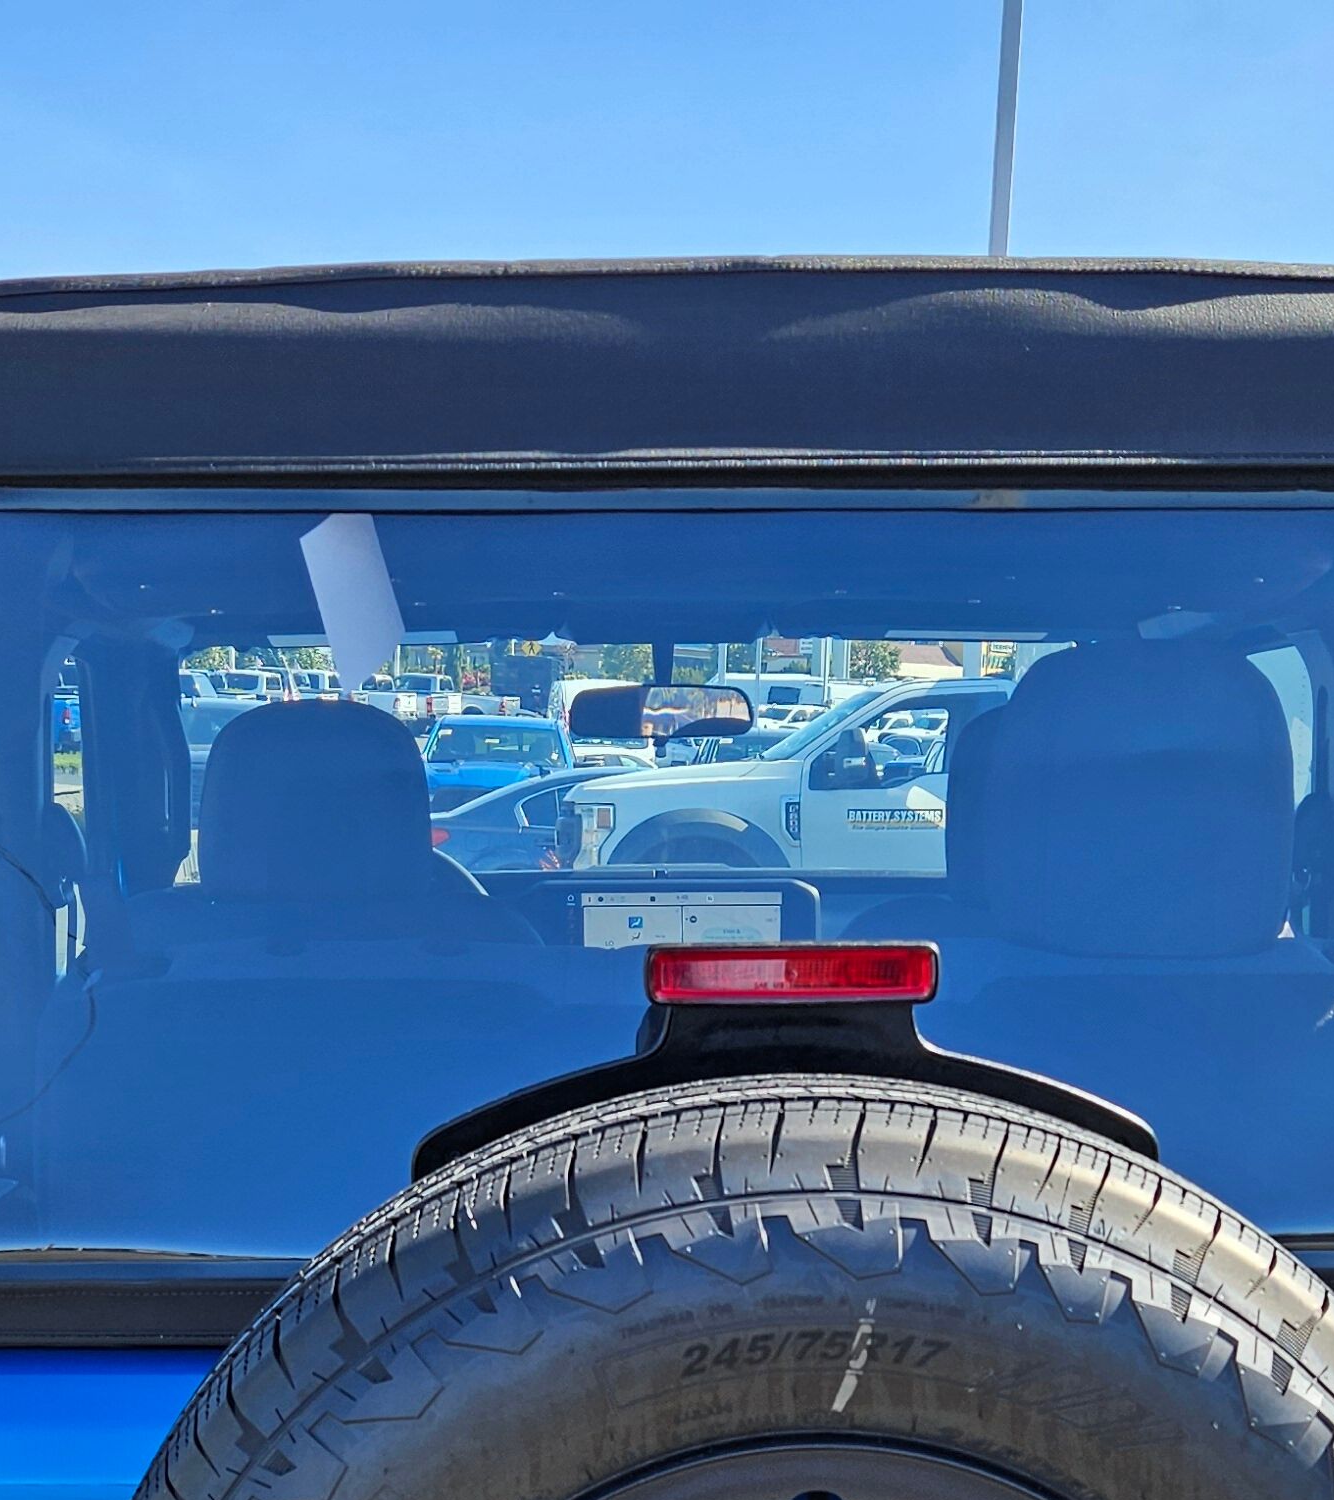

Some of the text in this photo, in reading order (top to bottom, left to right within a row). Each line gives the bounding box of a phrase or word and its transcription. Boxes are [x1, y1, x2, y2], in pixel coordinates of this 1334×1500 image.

[848, 810, 942, 822] BATTERY SYSTEMS
[681, 1327, 951, 1379] 245/75R17
